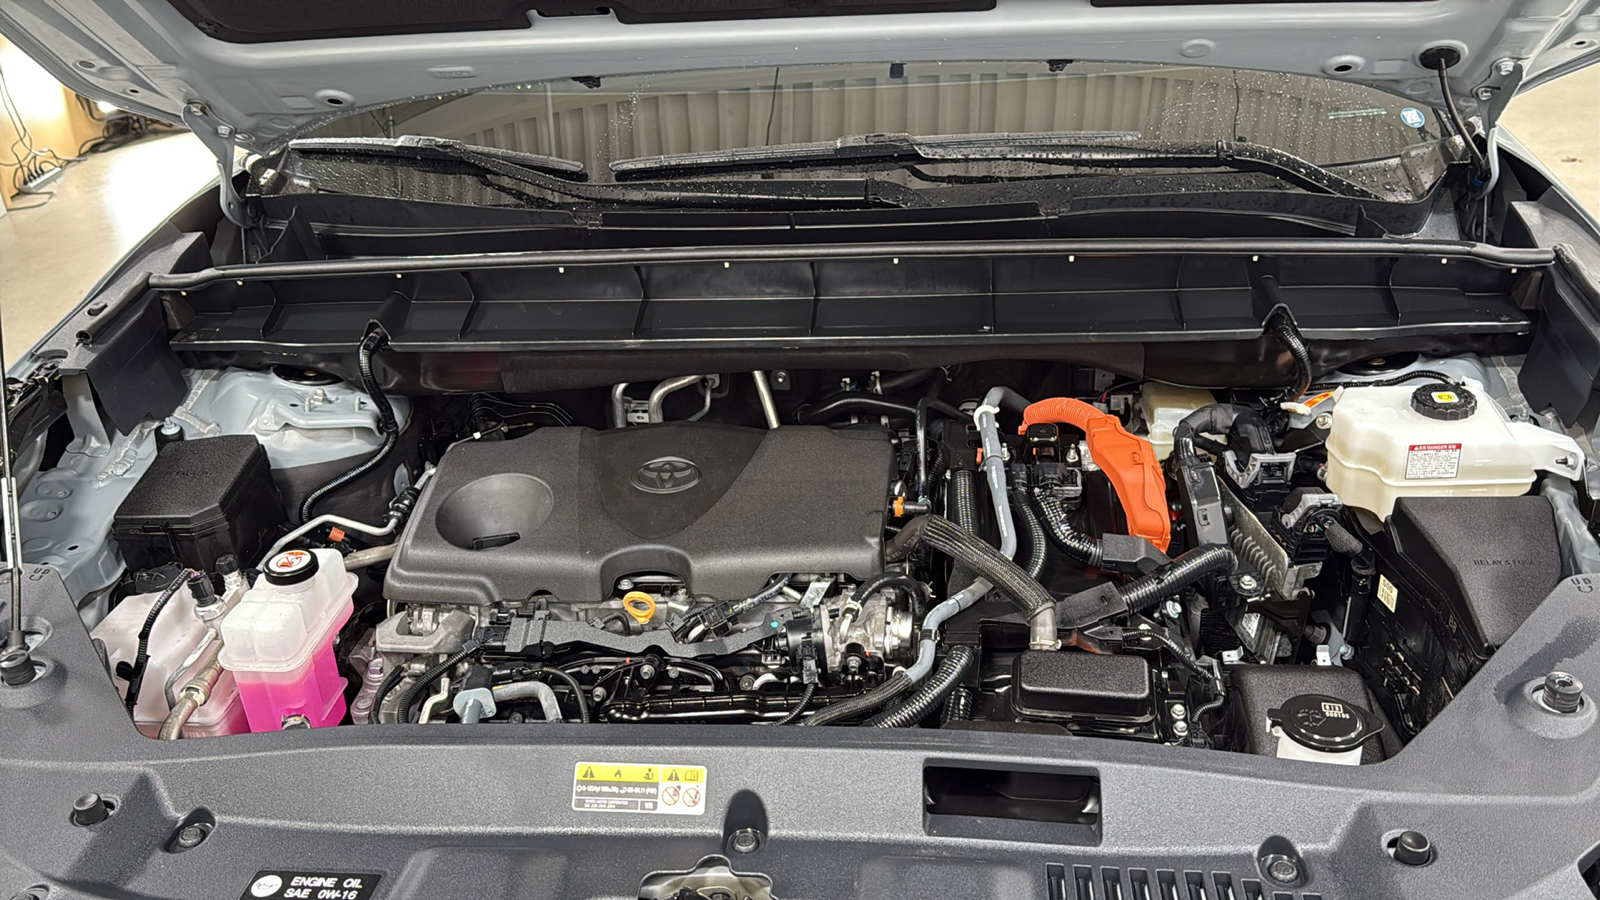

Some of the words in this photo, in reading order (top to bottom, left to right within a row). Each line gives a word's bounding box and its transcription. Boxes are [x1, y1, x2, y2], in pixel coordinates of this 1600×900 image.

[290, 876, 338, 887] ENGINE
[342, 878, 363, 888] OIL
[283, 888, 312, 898] SAE
[317, 889, 358, 900] 0W-16
